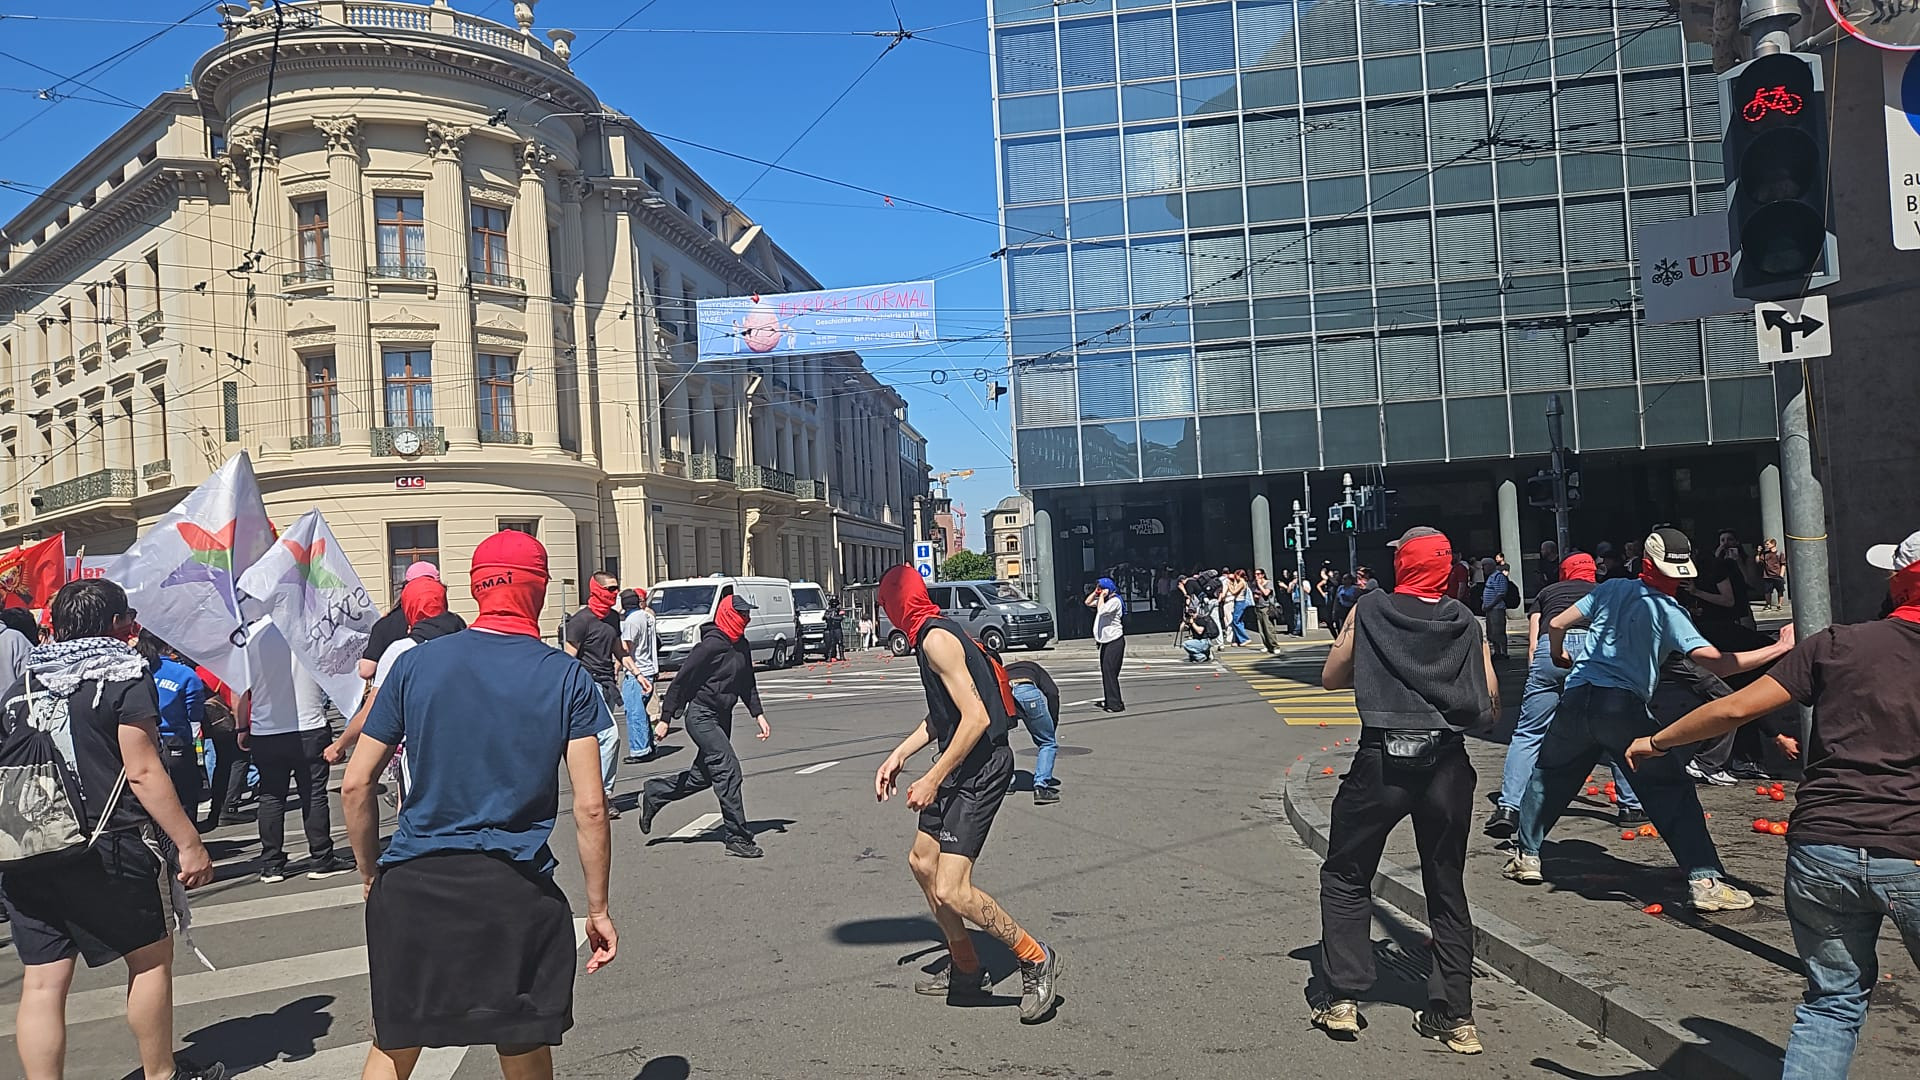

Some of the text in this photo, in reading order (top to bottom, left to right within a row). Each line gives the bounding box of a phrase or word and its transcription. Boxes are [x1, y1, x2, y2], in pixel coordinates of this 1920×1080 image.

[1686, 251, 1732, 277] UB
[856, 288, 929, 313] NORMAL
[397, 477, 422, 486] CIC
